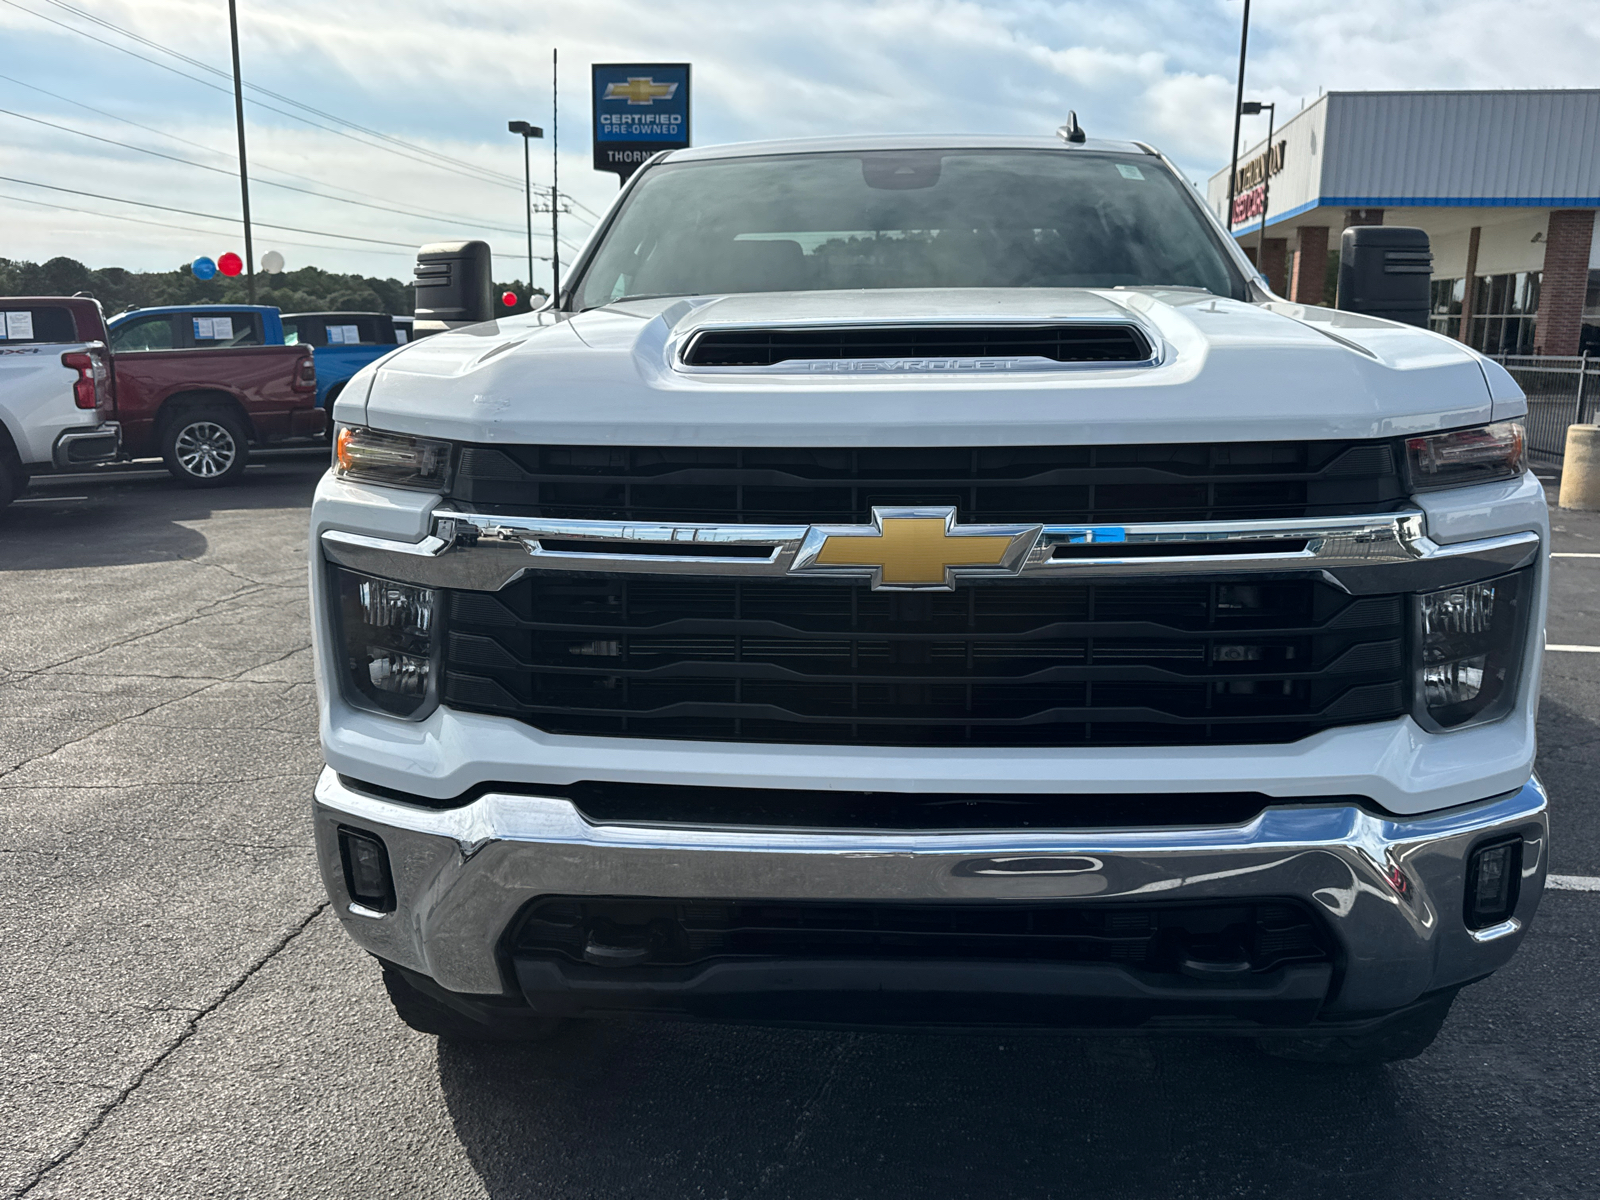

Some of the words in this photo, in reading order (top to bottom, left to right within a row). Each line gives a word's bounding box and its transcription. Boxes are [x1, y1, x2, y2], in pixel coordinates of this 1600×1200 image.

[600, 114, 682, 124] CERTIFIED
[604, 124, 678, 134] PRE-OWNED
[1243, 140, 1287, 190] THORNON
[0, 348, 42, 356] X4
[809, 359, 1019, 372] CHEVROLET
